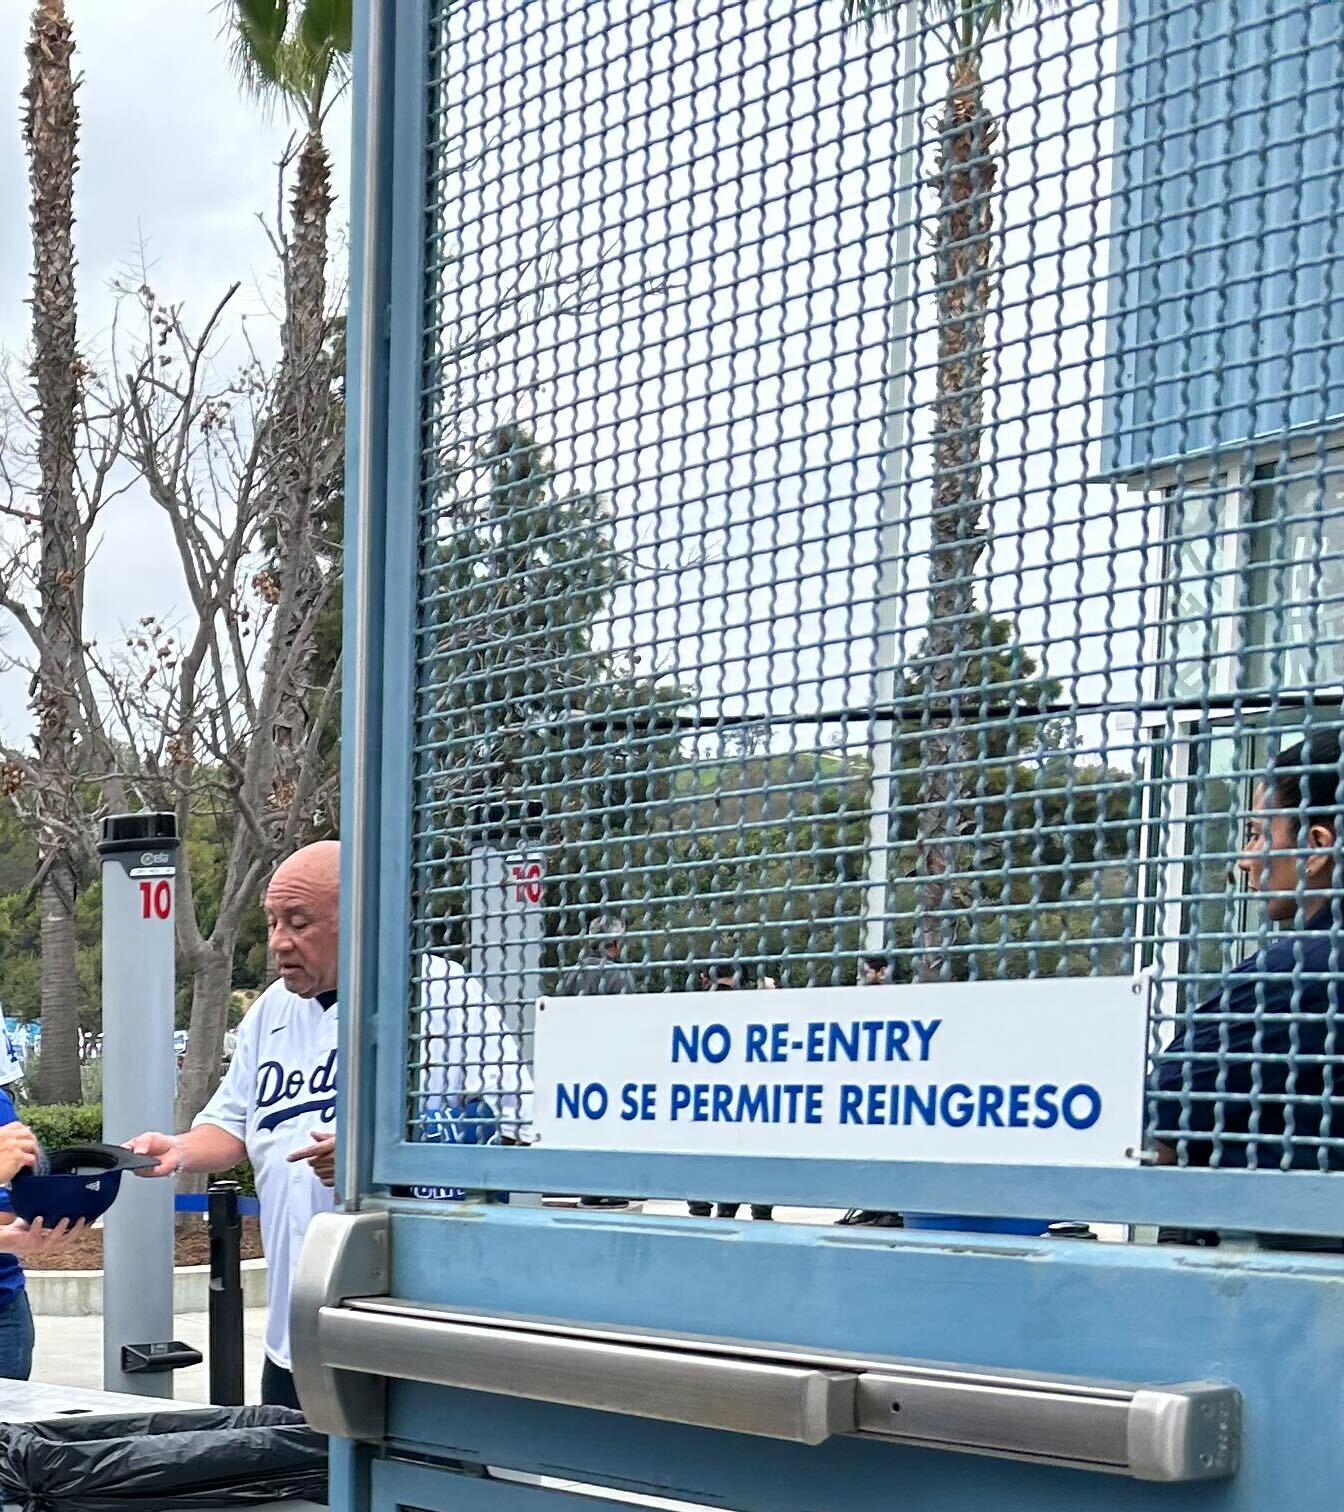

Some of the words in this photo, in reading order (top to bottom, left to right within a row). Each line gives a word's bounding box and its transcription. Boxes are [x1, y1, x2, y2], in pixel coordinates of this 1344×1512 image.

[140, 880, 171, 919] 10
[512, 865, 543, 903] 10
[671, 1023, 731, 1063] NO
[745, 1019, 943, 1063] RE-ENTRY
[556, 1083, 608, 1120] NO
[620, 1083, 656, 1121] SE
[671, 1084, 823, 1124] PERMITE
[839, 1083, 1102, 1130] REINGRESO
